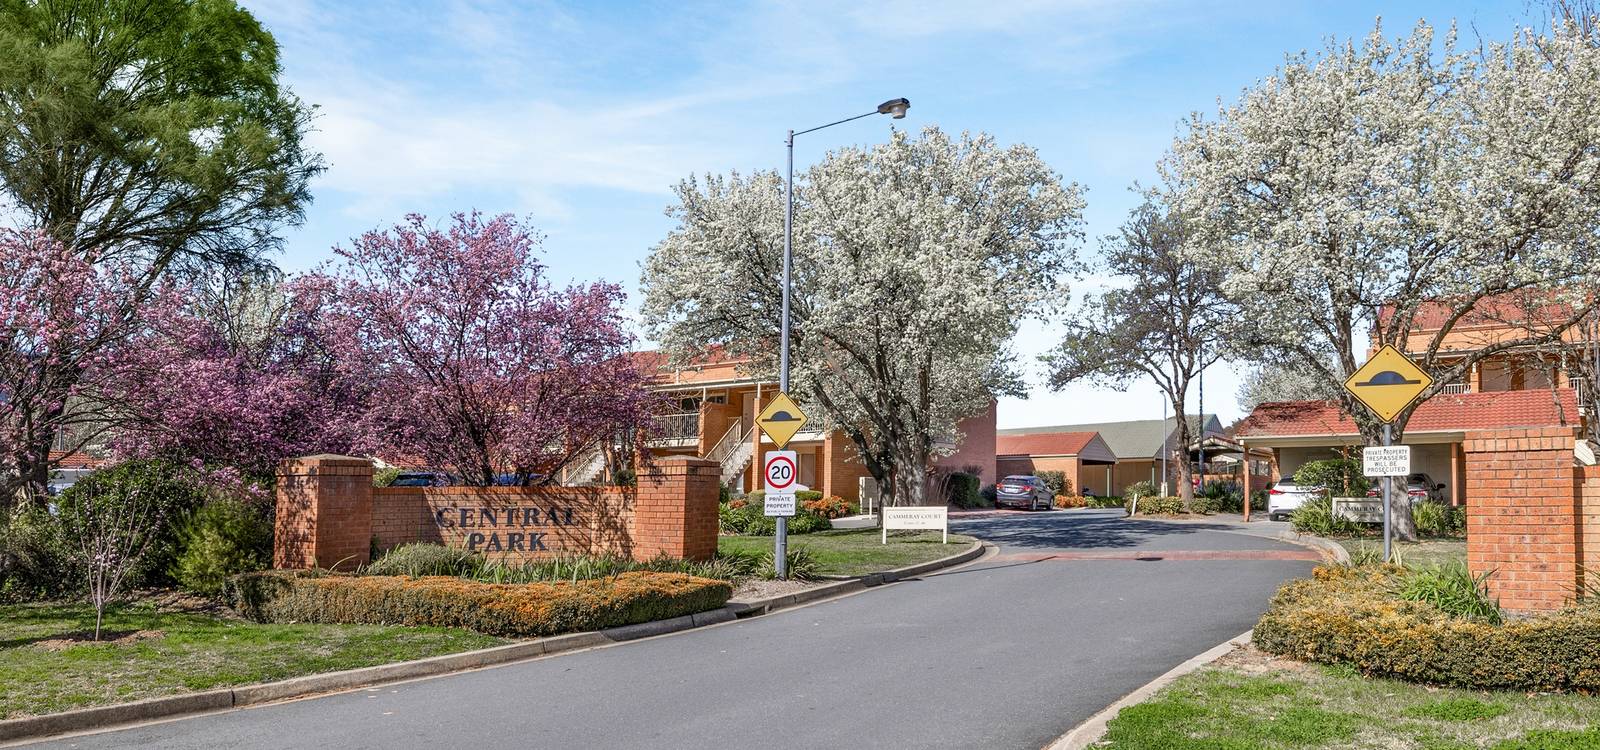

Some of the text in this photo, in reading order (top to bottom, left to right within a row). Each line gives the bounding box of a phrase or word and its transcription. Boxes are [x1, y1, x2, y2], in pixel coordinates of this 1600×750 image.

[772, 466, 790, 479] 20
[436, 507, 580, 528] CENTRAL
[468, 532, 549, 552] PARK
